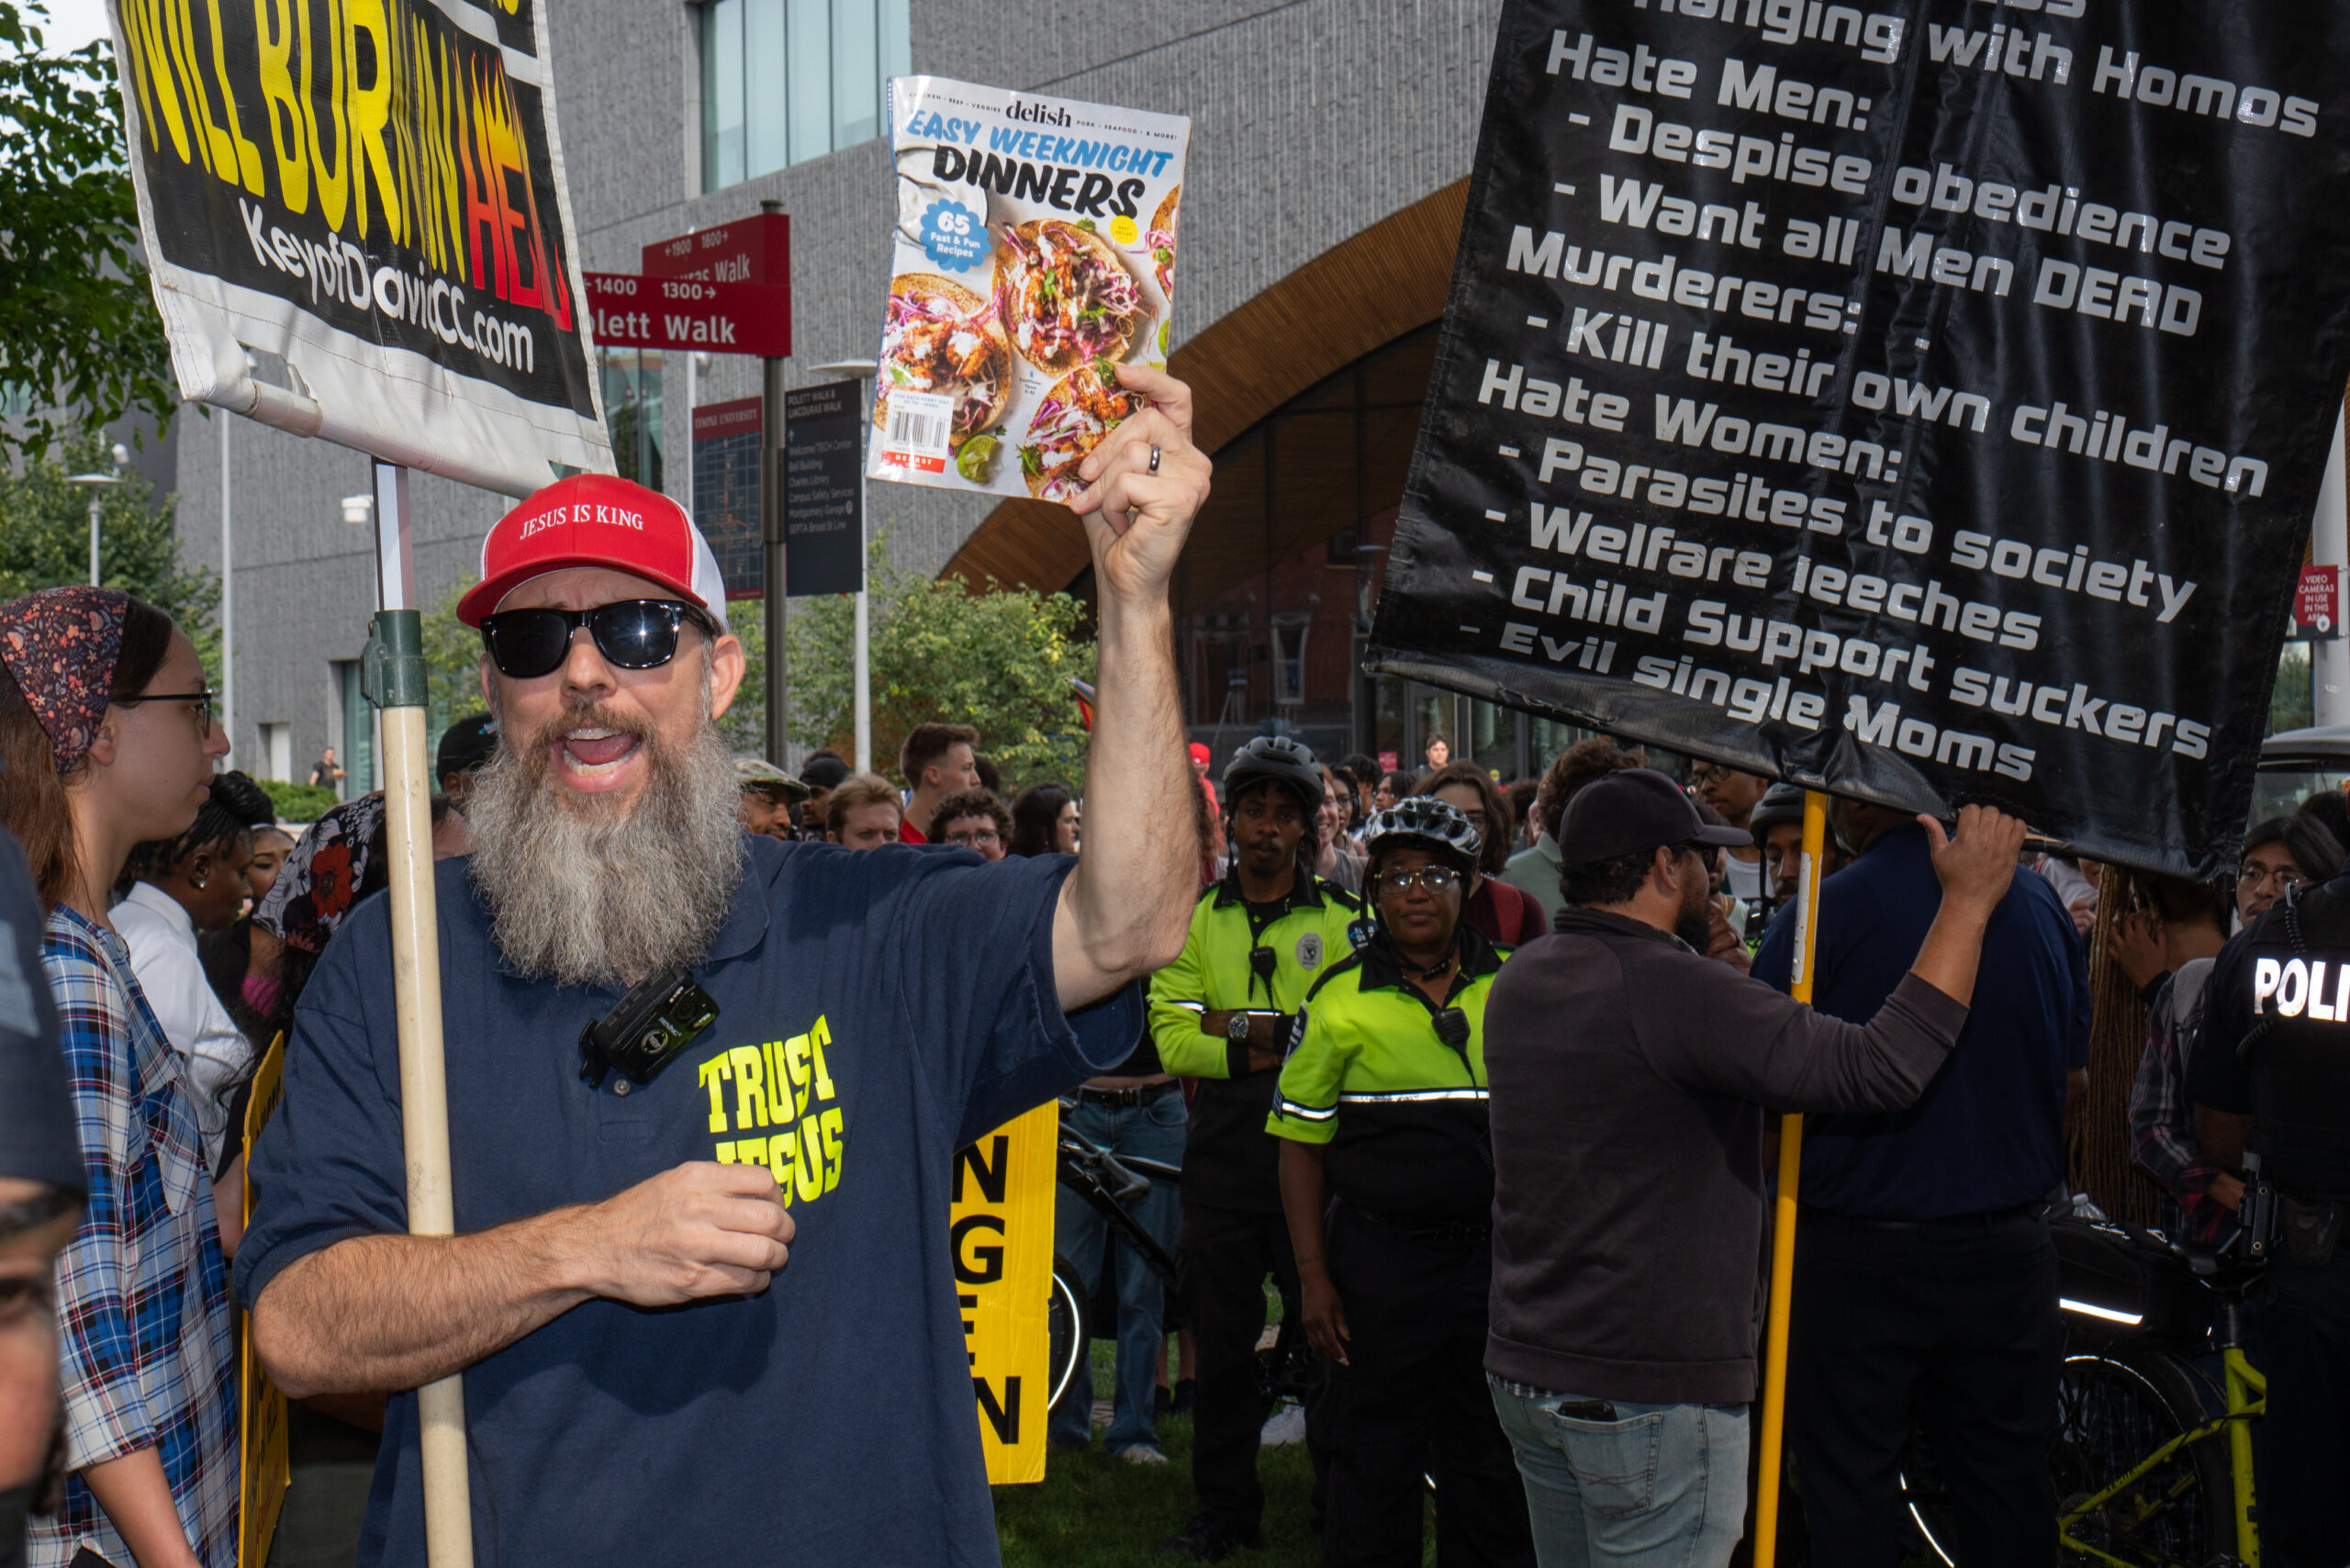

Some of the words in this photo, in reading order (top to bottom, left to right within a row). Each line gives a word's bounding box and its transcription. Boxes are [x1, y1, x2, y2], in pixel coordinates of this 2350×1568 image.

[120, 0, 266, 198] WILL
[1546, 29, 1697, 99] Hate
[1718, 58, 1872, 131] Men:
[1633, 0, 1906, 64] nging
[1929, 23, 2072, 85] with
[2092, 45, 2319, 138] Homos
[971, 103, 1001, 113] VEGGIES
[1006, 100, 1072, 129] delish
[1104, 124, 1137, 134] SEAFOOD
[906, 109, 982, 145] EASY
[990, 125, 1174, 178] WEEKNIGHT
[933, 144, 1146, 220] DINNERS
[1608, 103, 1872, 195] Despise
[1892, 162, 2231, 270] obedience
[931, 231, 951, 243] Fast
[953, 235, 960, 245] &
[963, 238, 980, 249] Fun
[936, 243, 973, 257] Recipes
[937, 210, 970, 236] 65
[1600, 173, 1766, 250] Want
[1783, 216, 1860, 265] all
[1875, 226, 2014, 297] Men
[2032, 257, 2202, 336] DEAD
[596, 277, 637, 296] 1400
[662, 281, 702, 300] 1300
[714, 252, 751, 283] Walk
[1505, 224, 1862, 335] Murderers:
[664, 314, 736, 344] Walk
[1477, 358, 1630, 432] Hate
[1655, 393, 1902, 483] Women:
[1566, 307, 1669, 370] Kill
[1685, 330, 1835, 398] their
[1852, 371, 1991, 433] own
[2010, 401, 2268, 497] children
[520, 507, 566, 541] JESUS
[573, 504, 591, 522] IS
[596, 505, 643, 531] KING
[1538, 437, 1847, 535] Parasites
[1866, 499, 1933, 554] to
[1951, 530, 2197, 623] society
[1530, 501, 1773, 588] Welfare
[1791, 554, 2042, 651] leeches
[2299, 583, 2334, 595] CAMERAS
[2304, 603, 2312, 613] IN
[2313, 602, 2329, 612] THIS
[2305, 574, 2328, 584] VIDEO
[2305, 593, 2313, 603] IN
[2314, 593, 2328, 602] USE
[2307, 612, 2325, 622] ARE
[1511, 566, 1668, 634] Child
[1683, 599, 1935, 692] Support
[1949, 666, 2210, 759] suckers
[1499, 621, 1617, 674] Evil
[1632, 655, 1826, 731] single
[1842, 694, 2036, 781] Moms
[2254, 958, 2350, 1023] POLI
[699, 1014, 835, 1134] TRUST
[716, 1107, 844, 1210] SUS
